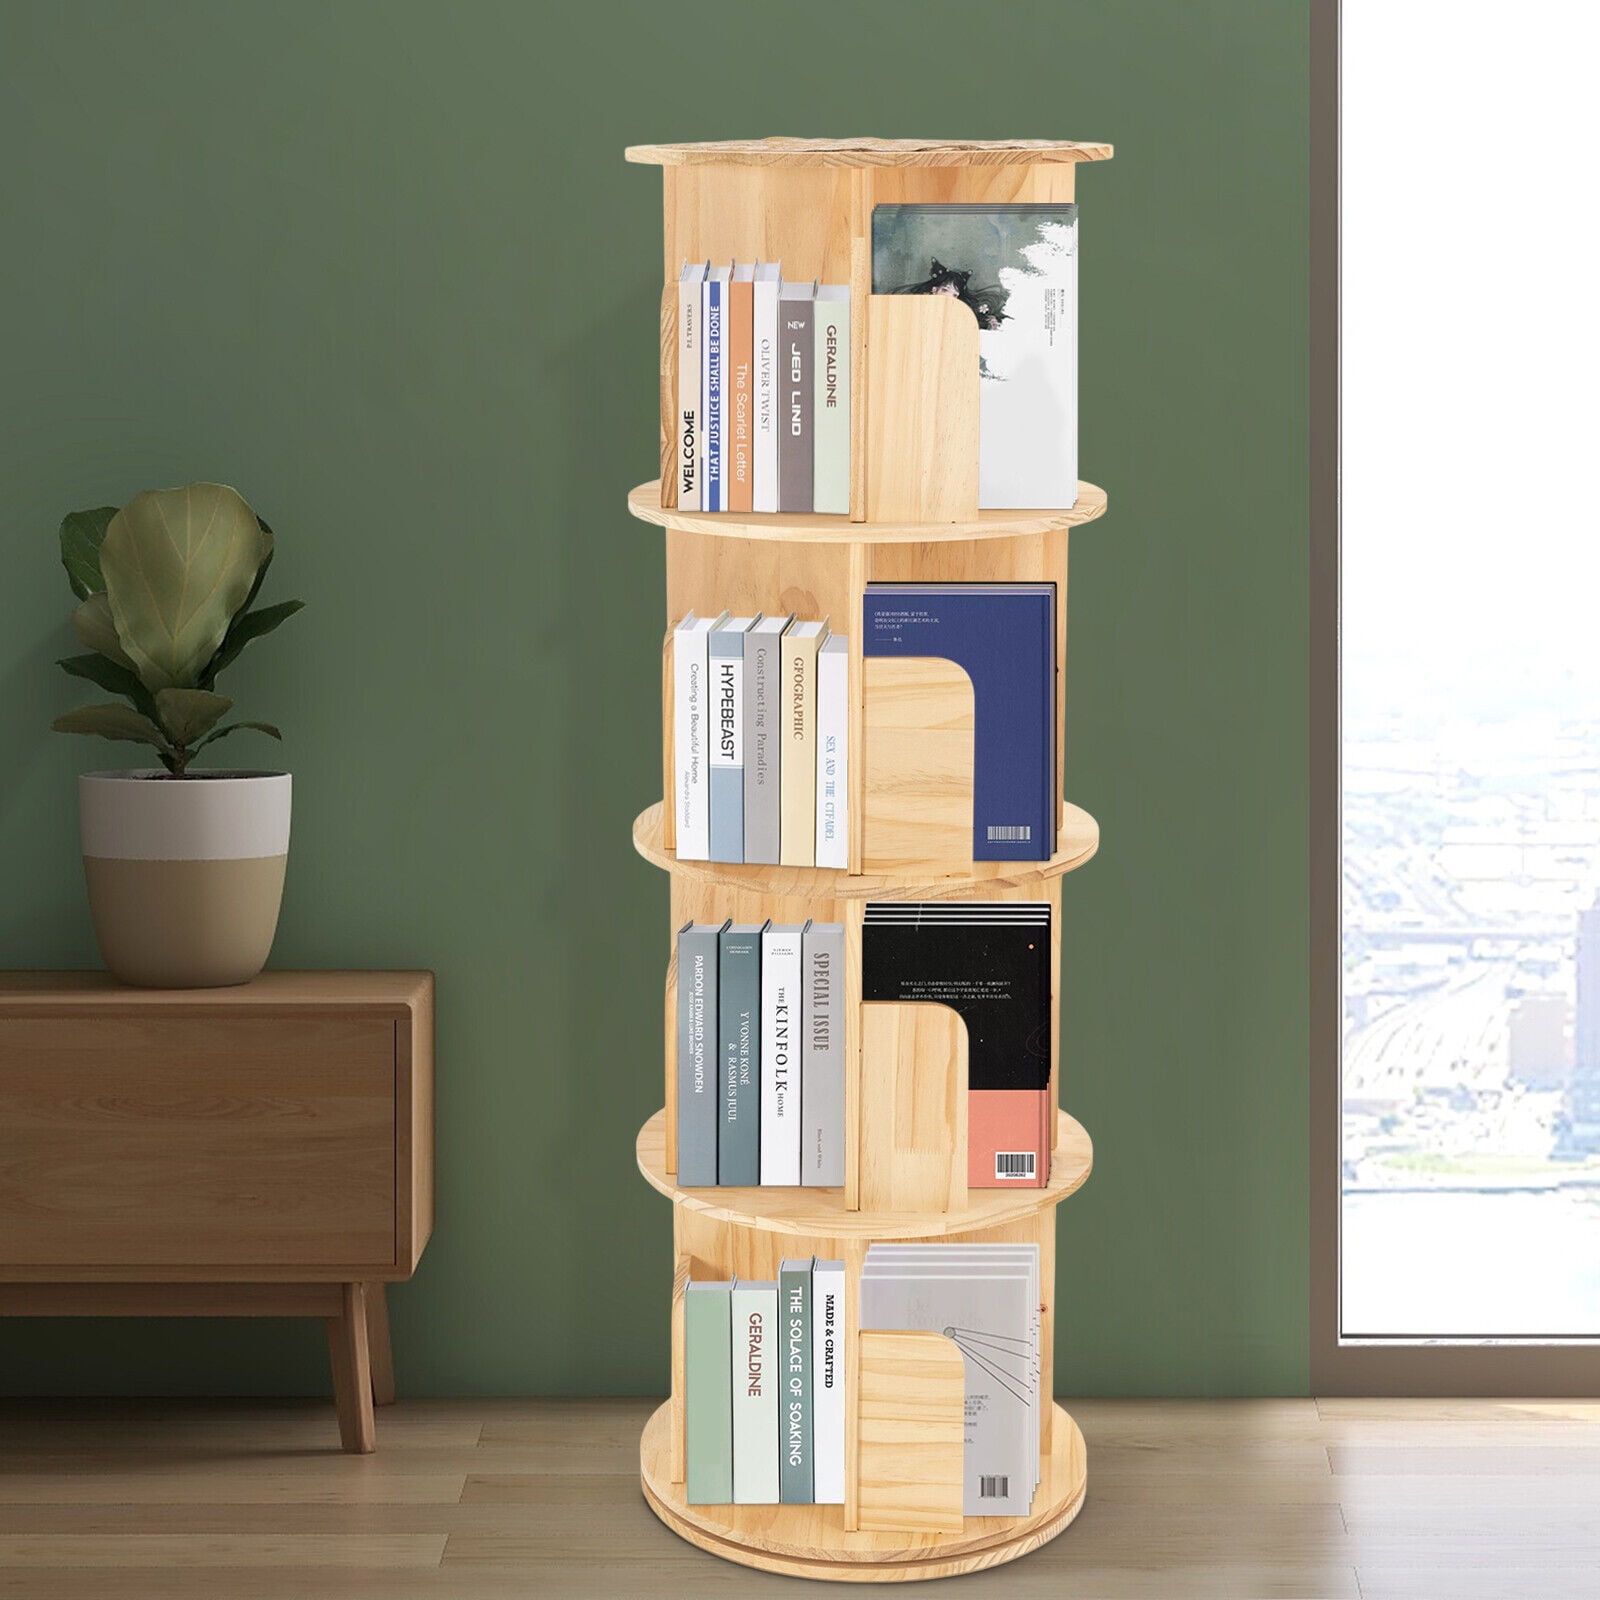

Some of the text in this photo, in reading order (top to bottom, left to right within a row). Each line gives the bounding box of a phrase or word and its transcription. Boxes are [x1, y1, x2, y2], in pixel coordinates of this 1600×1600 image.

[787, 320, 806, 330] NEW
[826, 324, 837, 408] GERALDINE
[710, 305, 720, 482] THAT JUSTICE SHALL BE DONE
[736, 362, 748, 483] The Scarlet Letter
[761, 338, 770, 432] OLIVER TWIST
[791, 342, 801, 436] JED LIND
[683, 410, 695, 493] WELCOME
[688, 663, 699, 703] Creating
[720, 664, 734, 760] HYPEBEAST
[755, 648, 767, 727] Constructing
[690, 713, 699, 754] Beautiful
[690, 756, 699, 784] Home
[825, 757, 836, 776] AND
[694, 955, 704, 1094] PARDON EDWARD SNOWDEN
[740, 1011, 750, 1056] YVONNE
[813, 952, 830, 1051] SPECIAL ISSUE
[726, 1042, 737, 1123] & RASMUS JUUL
[775, 1005, 788, 1092] KINFOLK
[748, 1312, 763, 1397] GERALDINE
[789, 1286, 803, 1467] THE SOLACE OF SOAKING
[824, 1294, 835, 1389] MADE & CRAFTED
